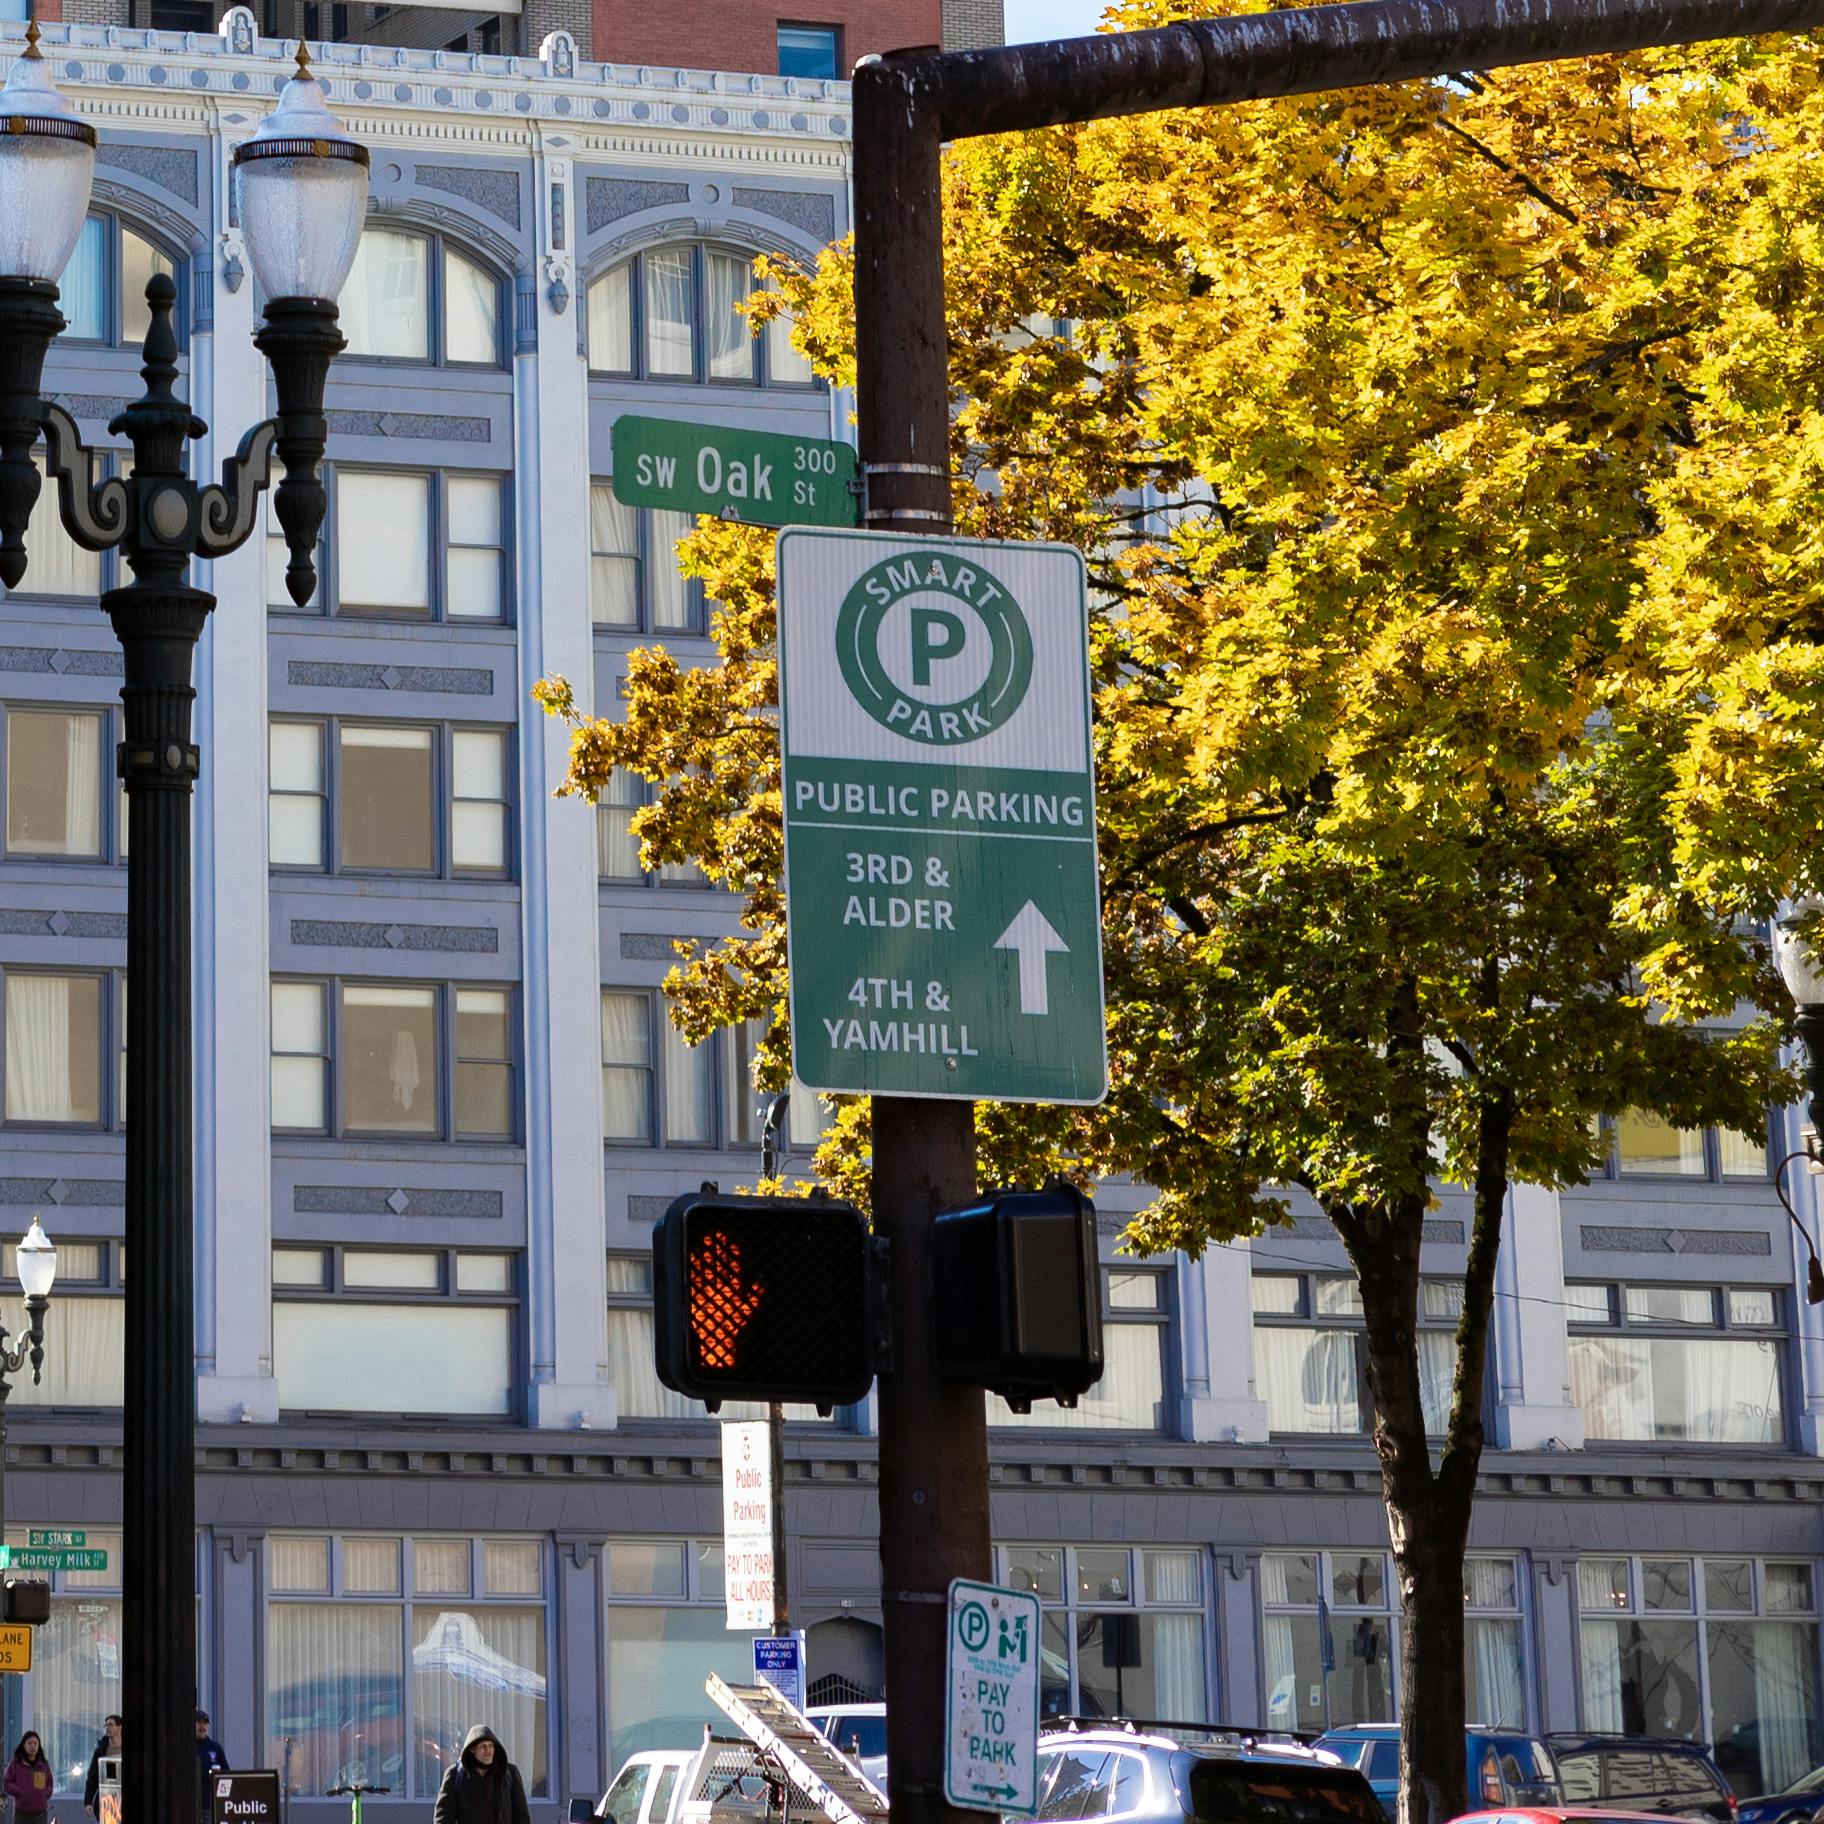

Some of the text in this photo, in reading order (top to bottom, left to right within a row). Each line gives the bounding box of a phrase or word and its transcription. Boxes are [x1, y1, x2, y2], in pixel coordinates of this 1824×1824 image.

[636, 446, 837, 501] SW Oak 300
[794, 479, 817, 507] St
[864, 559, 1004, 610] SMART
[911, 608, 966, 687] P
[886, 697, 993, 741] PARK
[795, 780, 1084, 827] PUBLIC PARKING
[846, 853, 951, 889] 3RD &
[843, 894, 956, 931] ALDER
[847, 977, 951, 1013] 4TH &
[823, 1018, 979, 1057] YAMHILL
[21, 1553, 62, 1568] Harvey
[66, 1553, 91, 1567] Milk
[967, 1611, 984, 1642] P
[977, 1679, 1010, 1707] PAY
[981, 1709, 1005, 1734] TO
[969, 1736, 1016, 1766] PARK
[224, 1800, 268, 1815] Public
